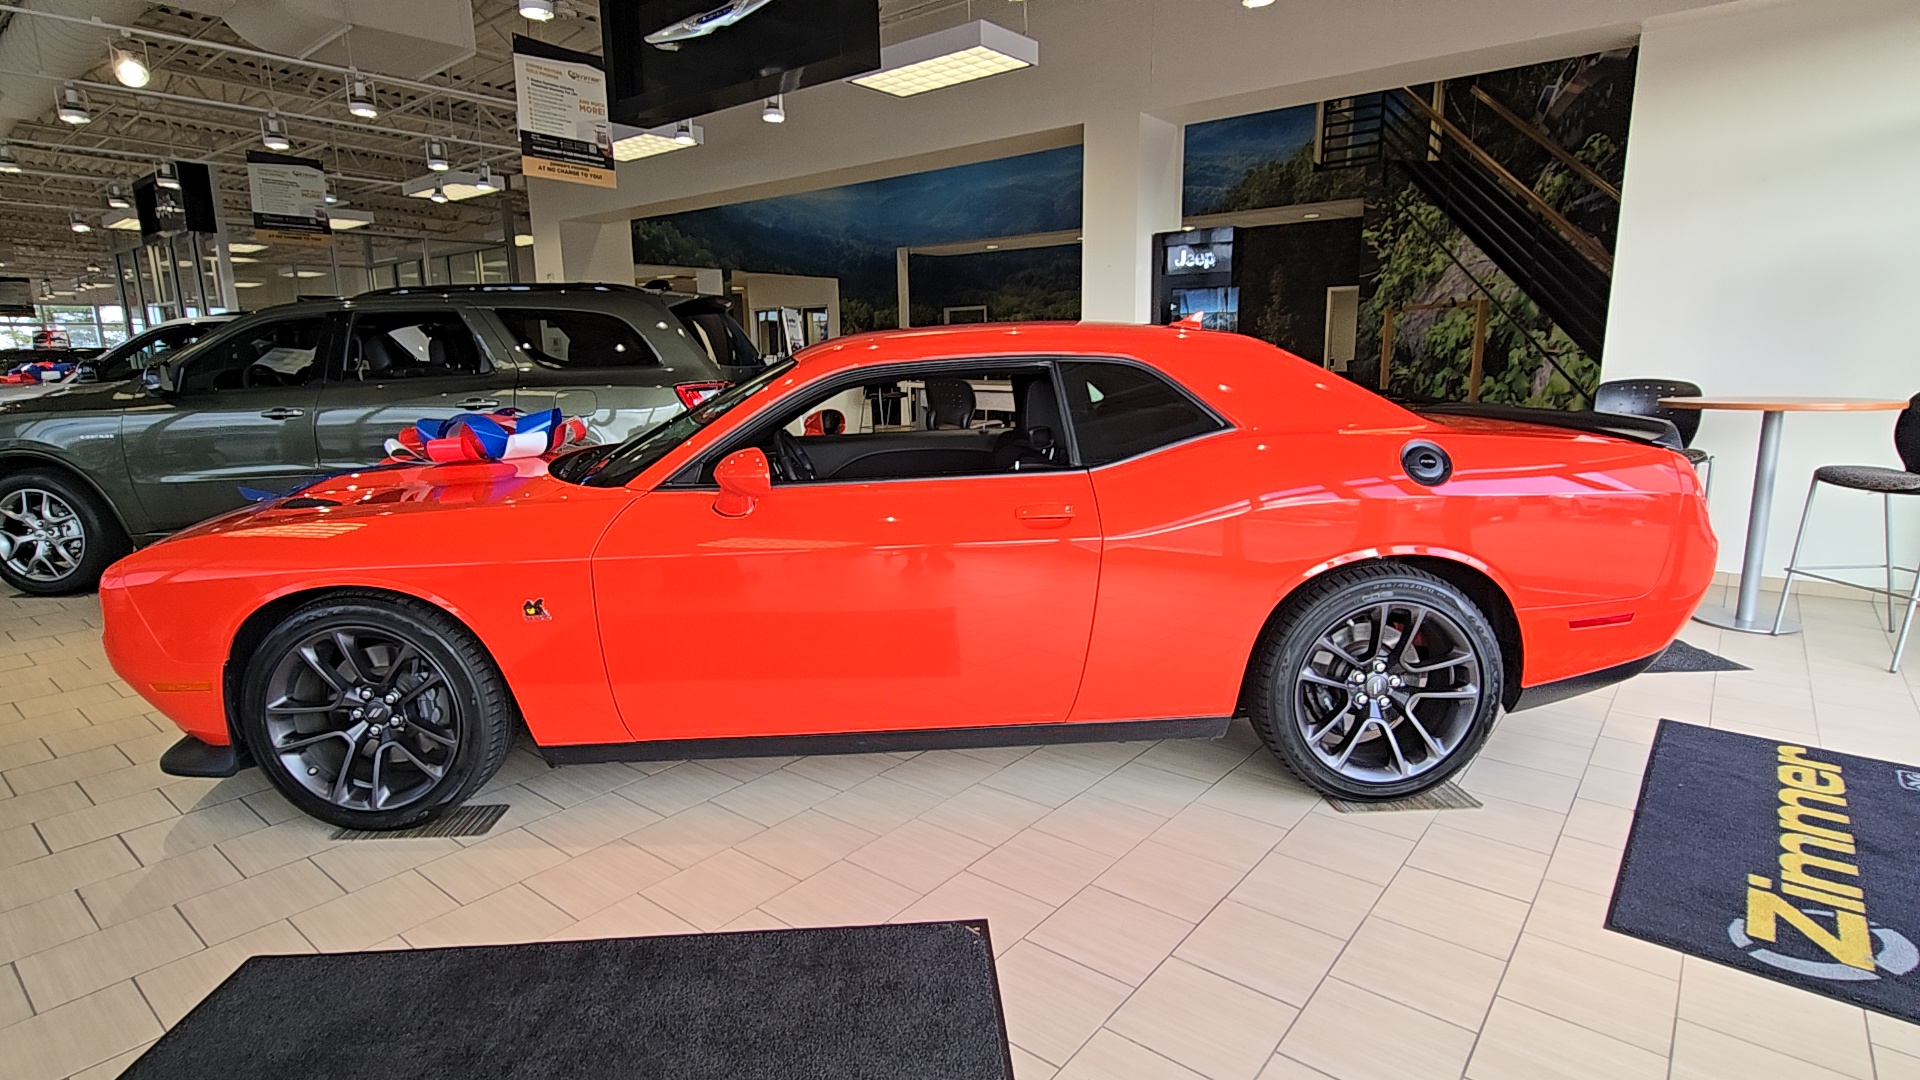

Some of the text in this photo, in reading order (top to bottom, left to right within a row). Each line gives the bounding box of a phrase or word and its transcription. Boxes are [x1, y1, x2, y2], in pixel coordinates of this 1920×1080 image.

[579, 104, 605, 116] MORE!
[557, 167, 579, 176] CHARGE
[1174, 250, 1216, 269] Jeep
[1746, 745, 1876, 972] Zimmer
